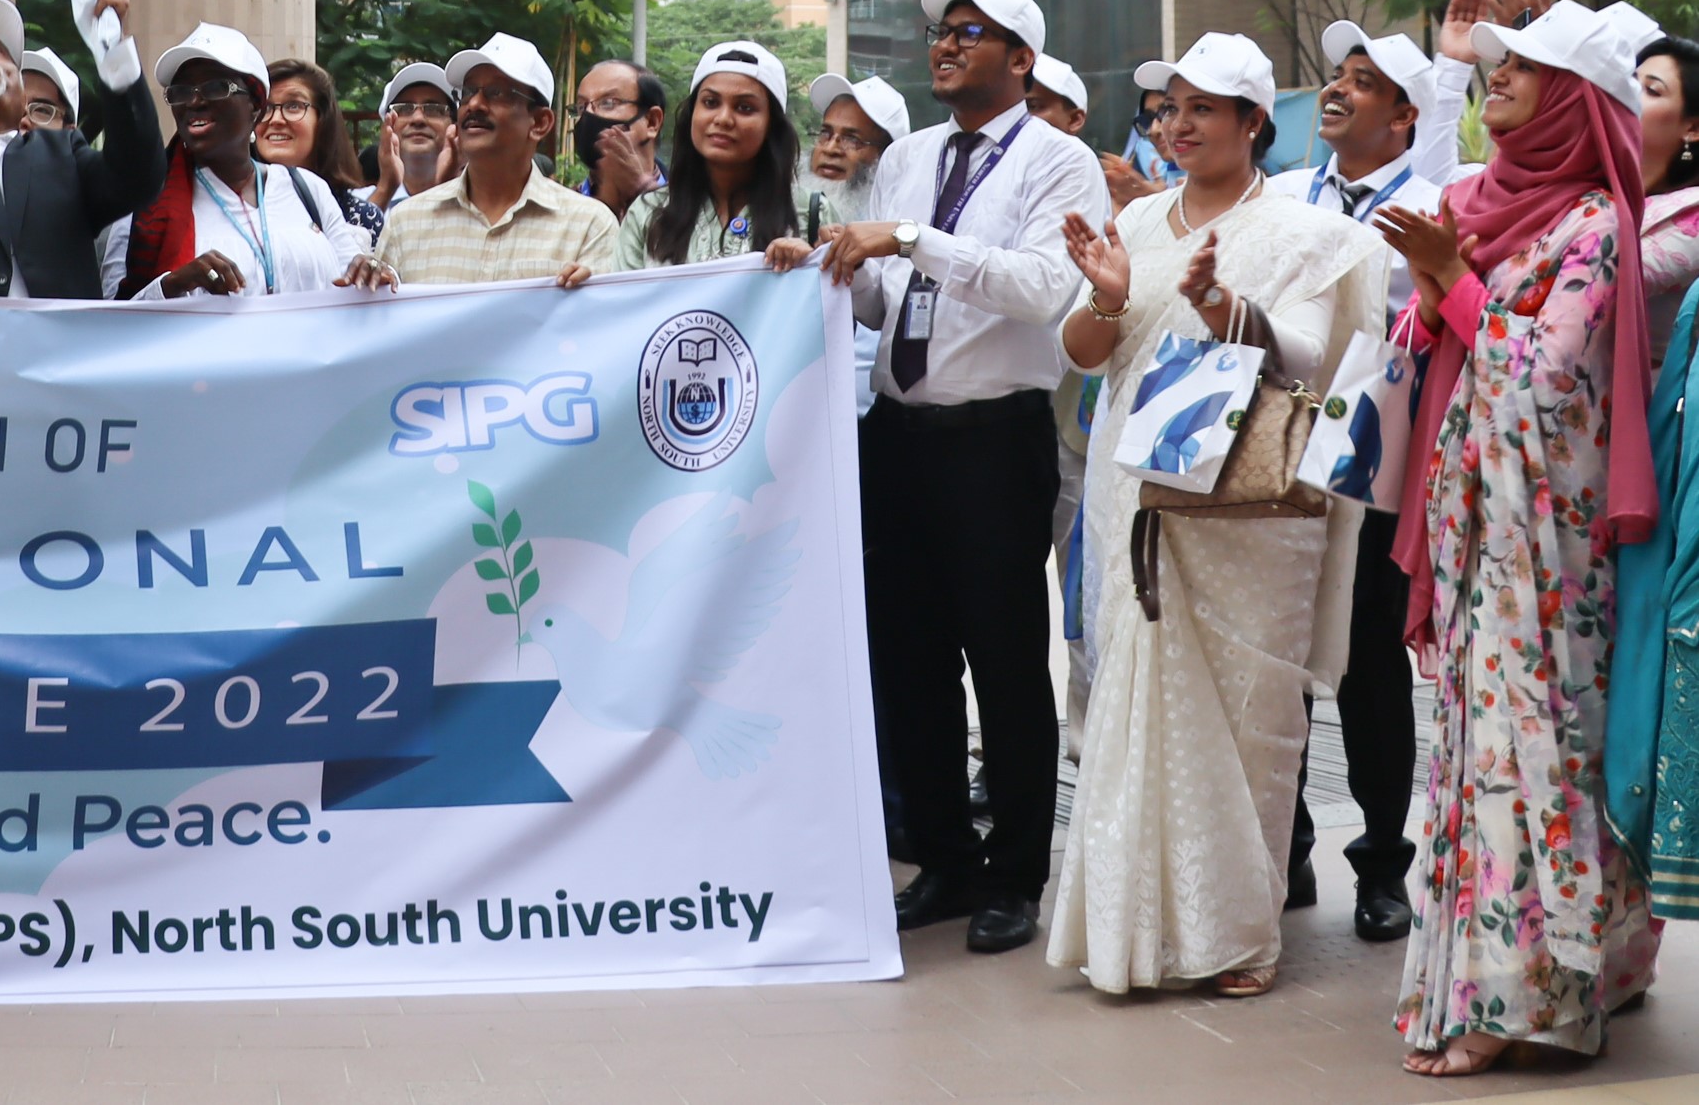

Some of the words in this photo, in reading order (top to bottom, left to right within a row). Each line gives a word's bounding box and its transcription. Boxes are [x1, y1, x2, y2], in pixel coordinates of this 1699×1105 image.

[652, 327, 676, 357] SEEK
[675, 314, 747, 361] KNOWLEDGE
[687, 372, 706, 382] 1992
[389, 371, 599, 457] SIPG
[642, 395, 661, 442] NORTH
[658, 441, 701, 468] SOUTH
[712, 389, 755, 460] UNIVERSITY
[43, 417, 138, 473] OF
[139, 666, 400, 733] 2022
[72, 794, 332, 850] Peace.
[111, 905, 276, 955] North
[290, 898, 462, 950] South
[476, 881, 775, 943] University
